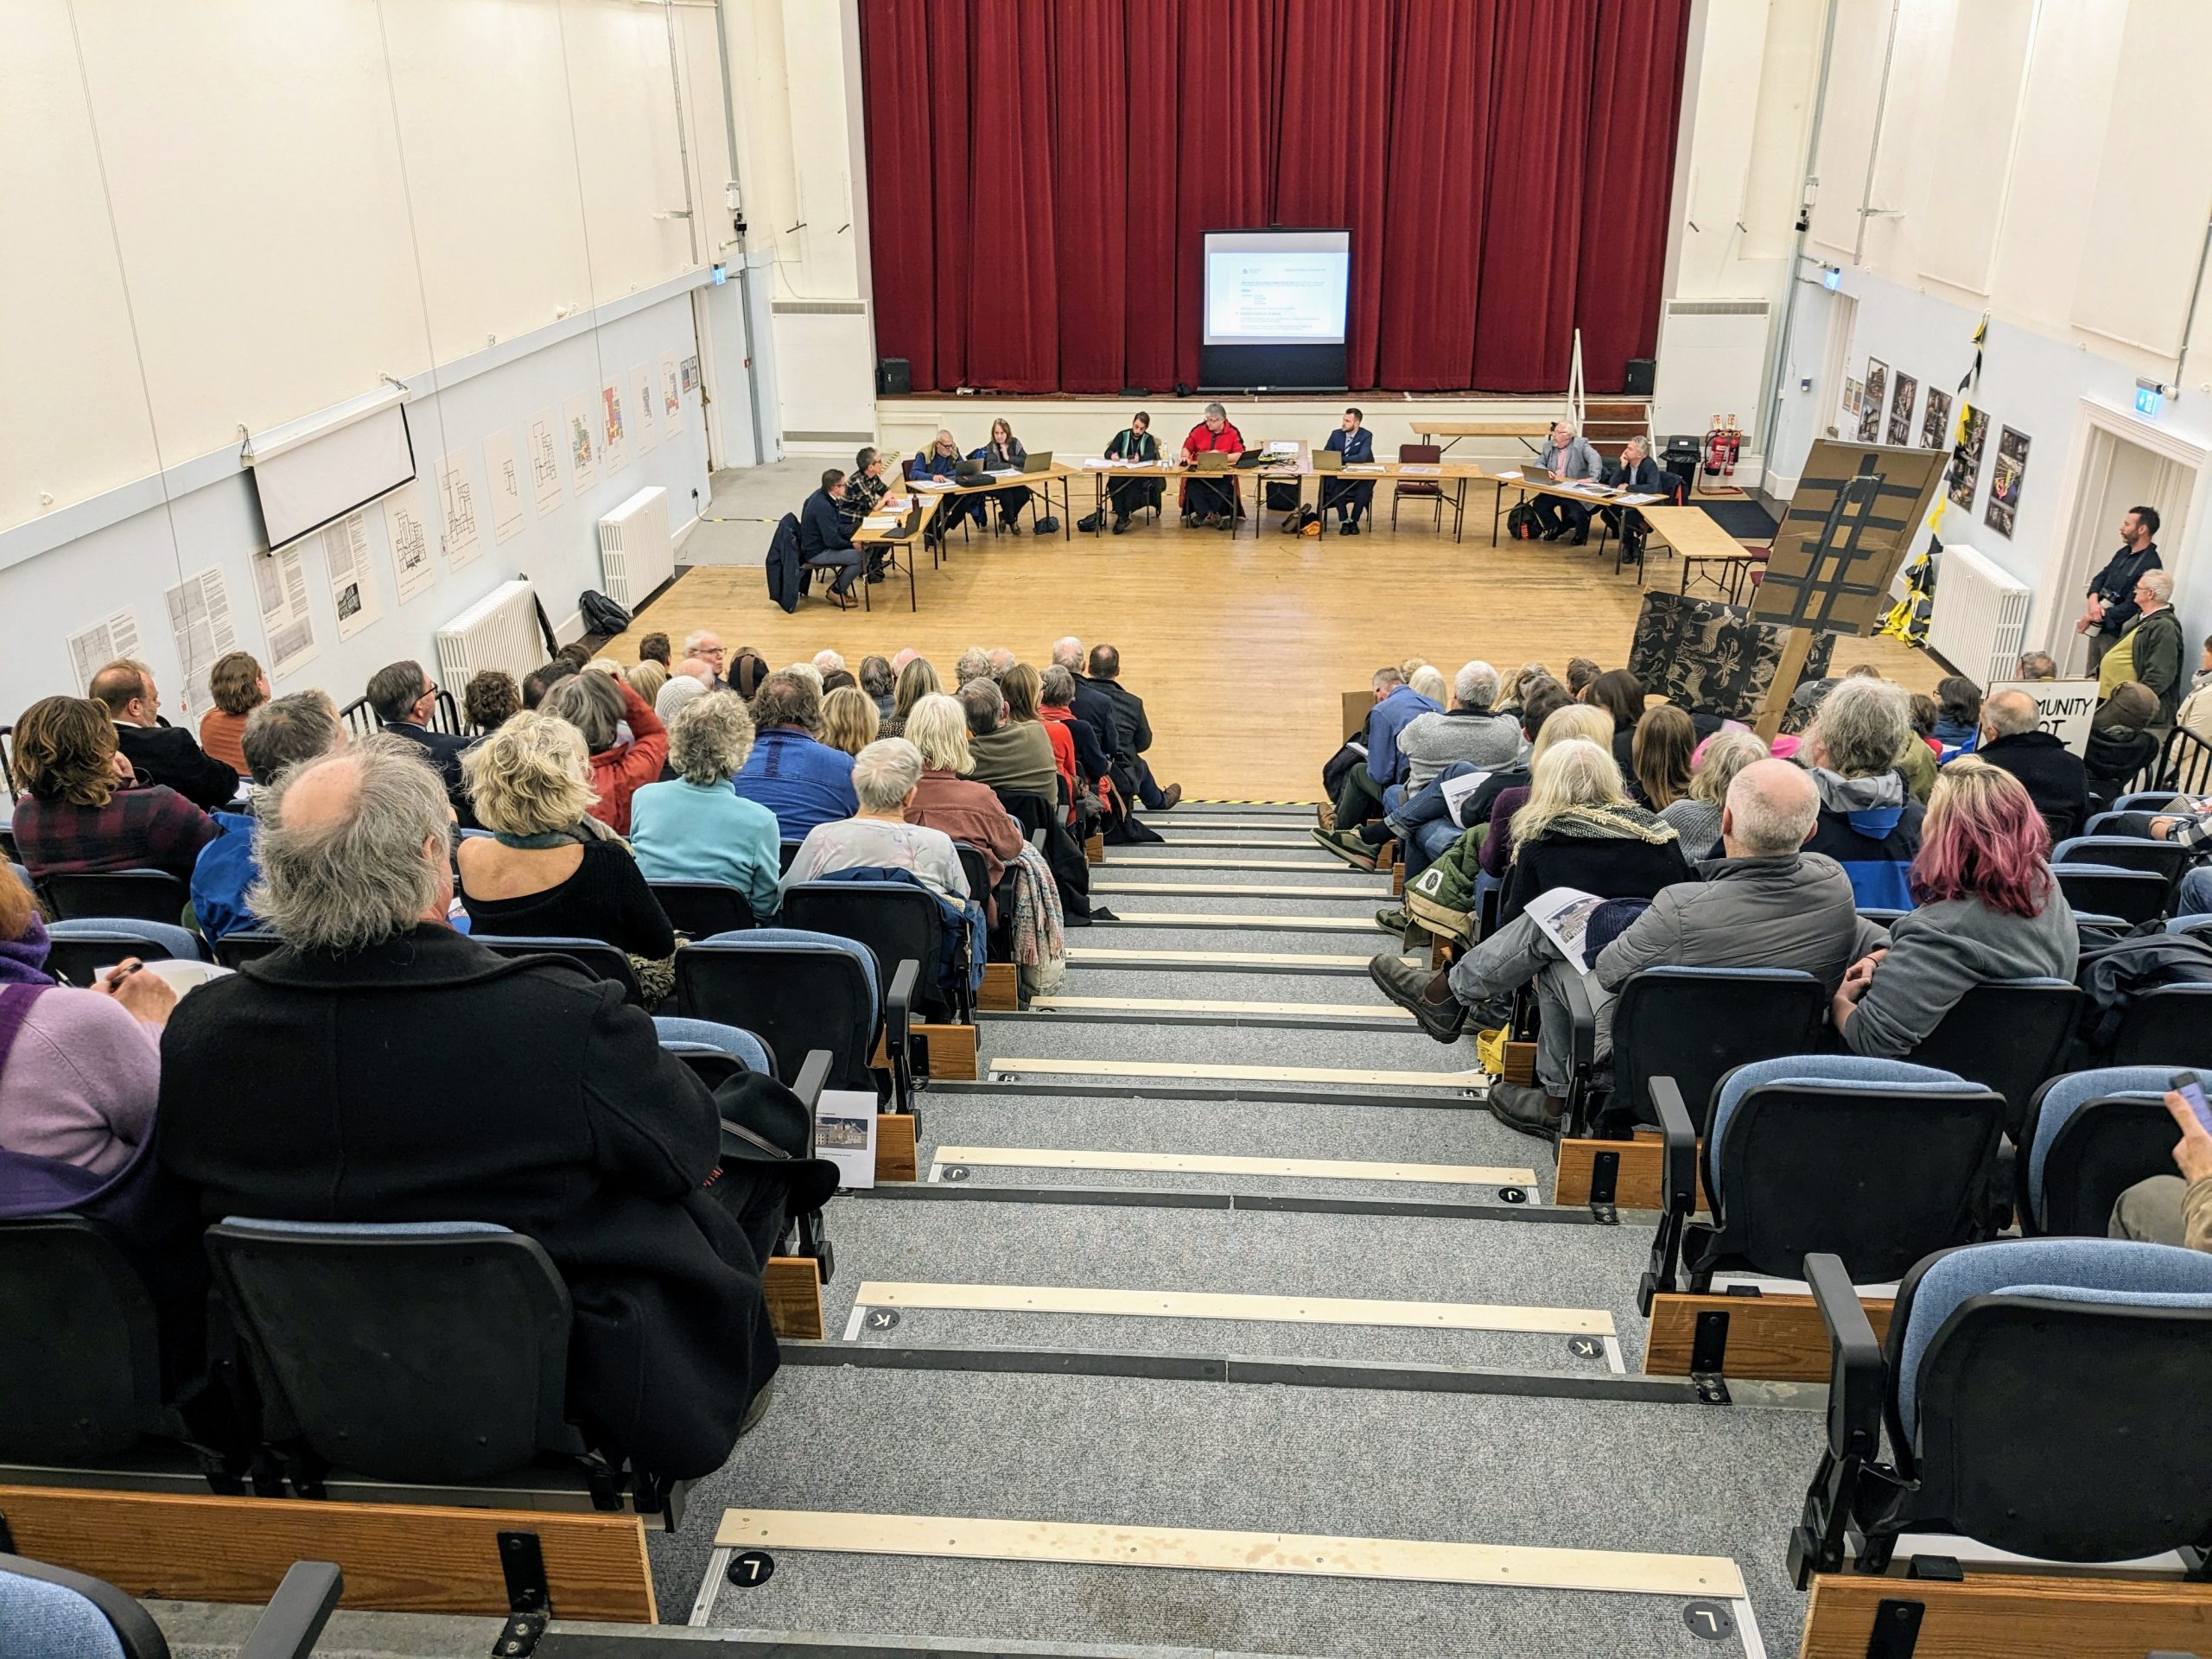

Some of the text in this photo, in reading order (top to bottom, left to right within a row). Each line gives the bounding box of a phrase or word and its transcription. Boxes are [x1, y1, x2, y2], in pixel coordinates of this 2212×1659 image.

[2035, 698, 2094, 716] MUNITY
[2039, 719, 2067, 736] OT
[874, 1313, 891, 1327] K
[1575, 1341, 1594, 1355] K
